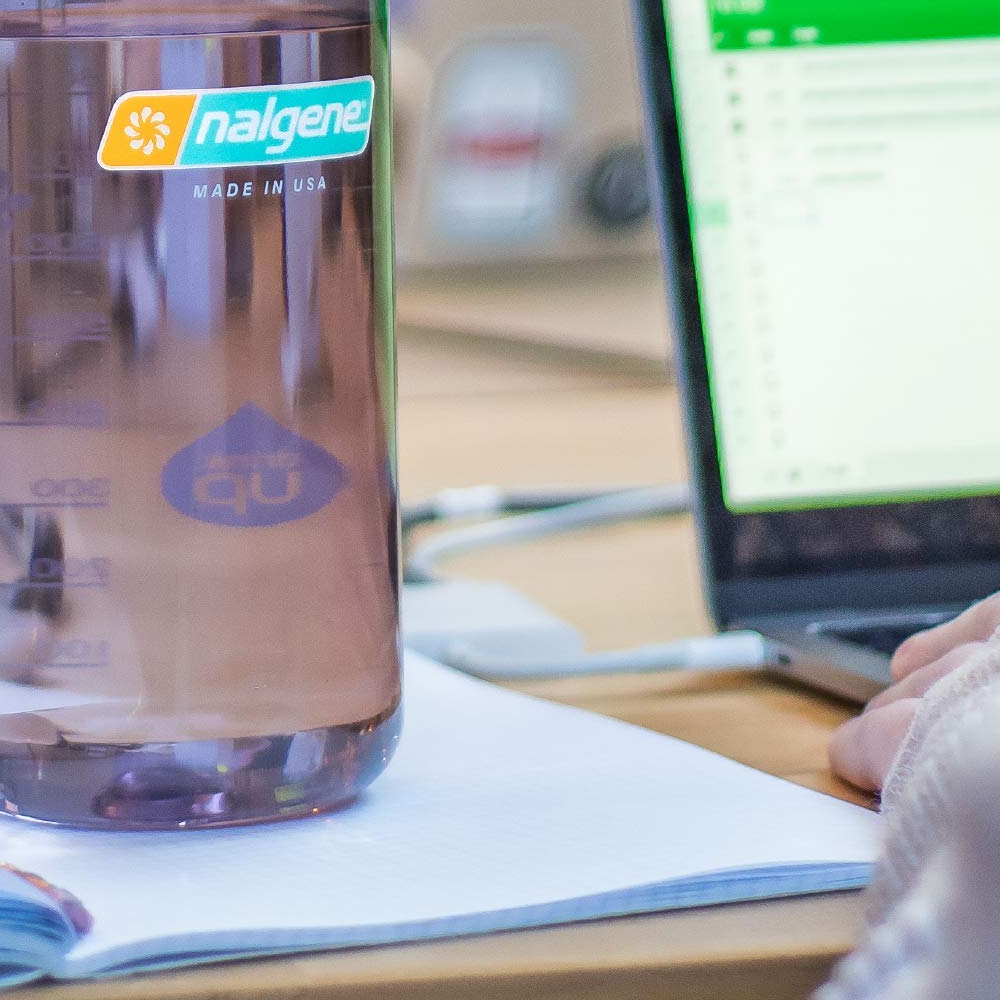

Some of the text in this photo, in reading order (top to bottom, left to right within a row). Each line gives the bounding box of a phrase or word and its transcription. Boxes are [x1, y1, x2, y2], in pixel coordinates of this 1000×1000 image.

[193, 175, 327, 198] MADE IN USA
